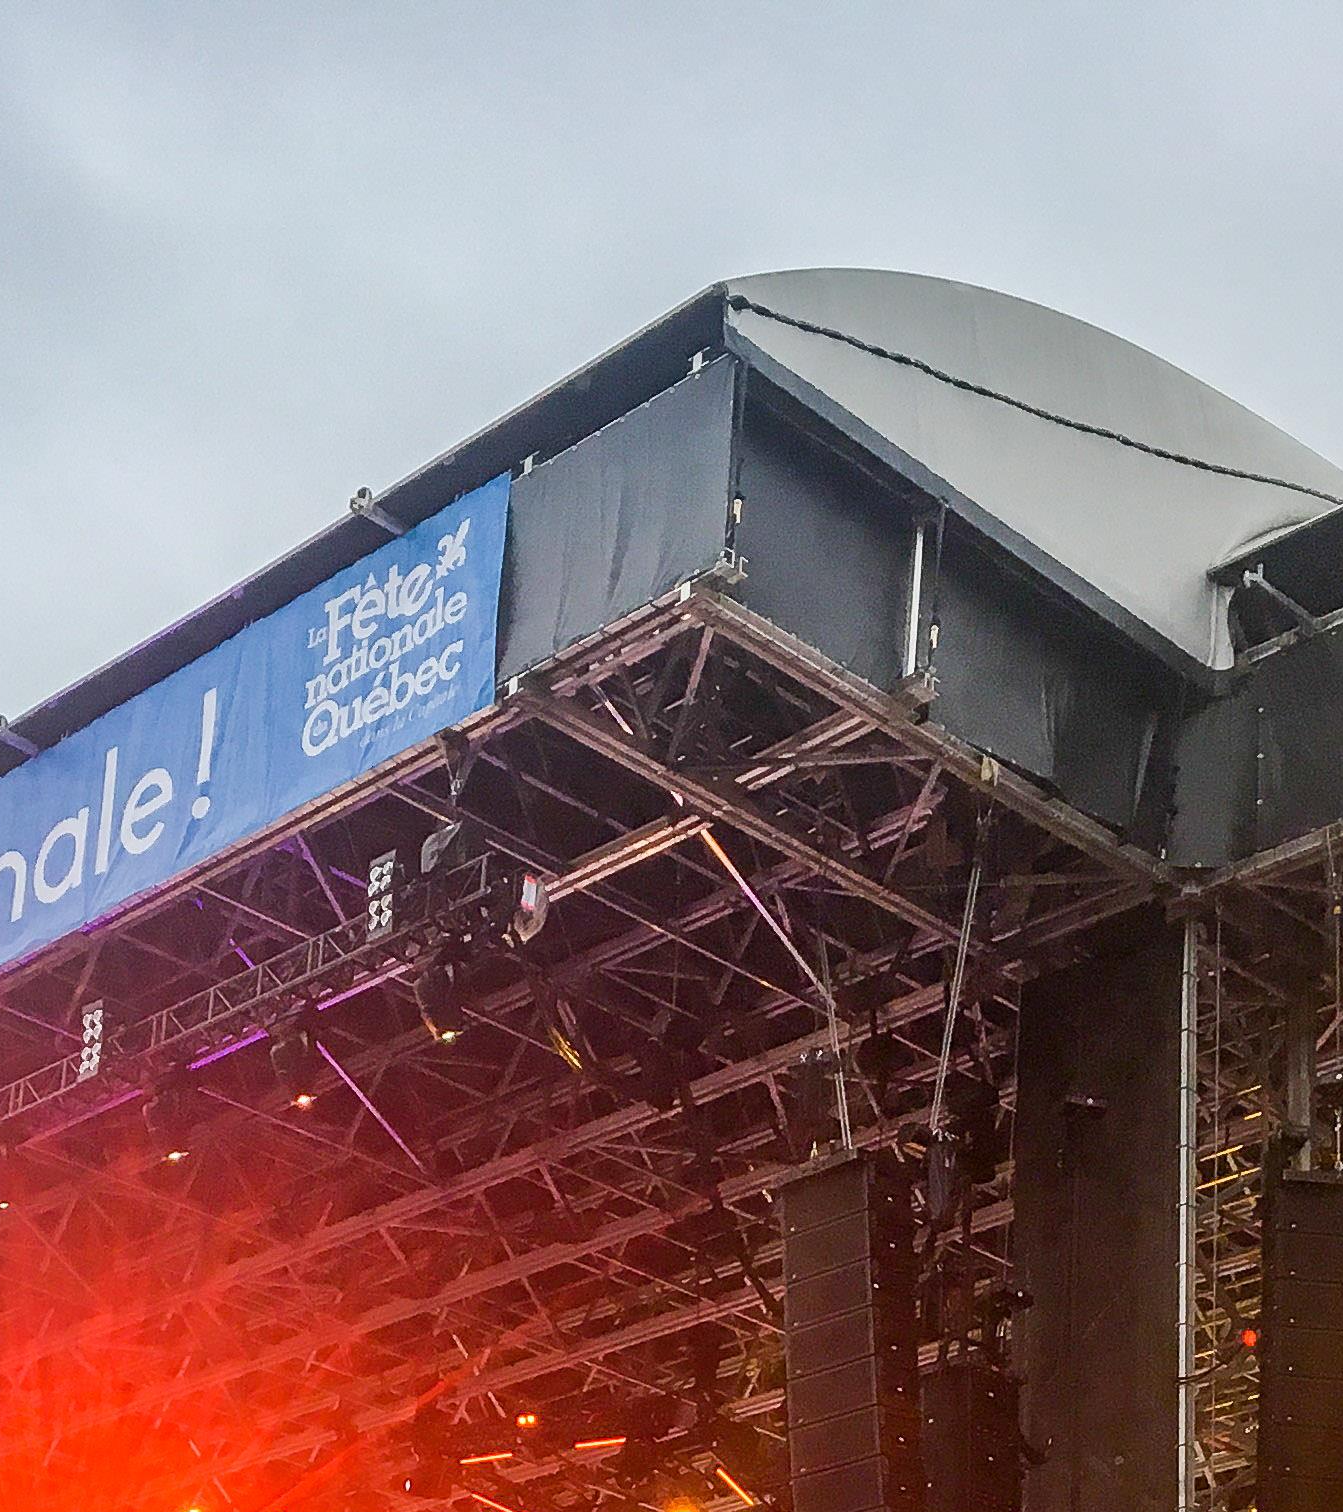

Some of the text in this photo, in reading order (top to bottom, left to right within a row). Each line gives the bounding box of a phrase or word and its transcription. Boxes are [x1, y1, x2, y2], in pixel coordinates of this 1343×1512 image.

[304, 587, 468, 710] nationale
[307, 563, 433, 667] La Fête
[301, 639, 465, 758] Québec
